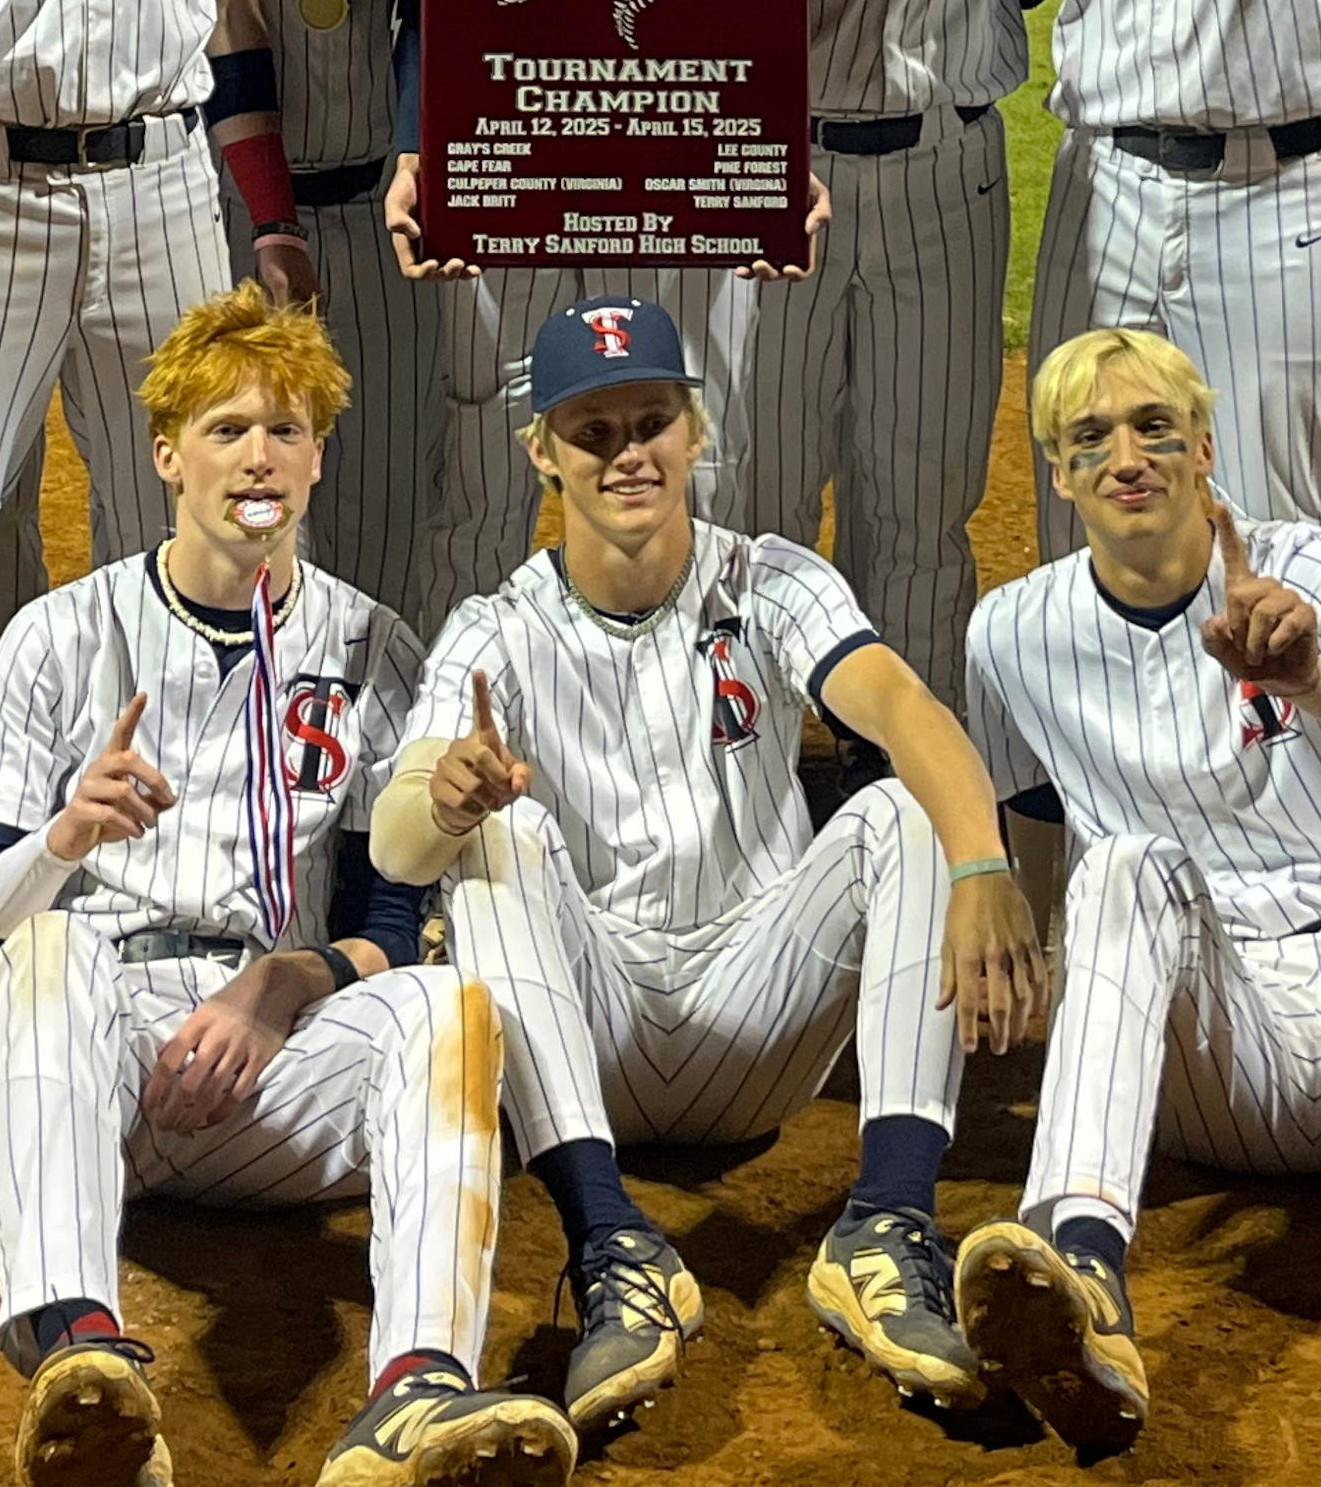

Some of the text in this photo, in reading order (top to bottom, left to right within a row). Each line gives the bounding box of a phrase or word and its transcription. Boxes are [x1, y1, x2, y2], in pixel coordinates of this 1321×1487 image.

[531, 118, 557, 137] 12,
[561, 118, 611, 136] 2025
[682, 118, 709, 138] 15,
[712, 118, 762, 137] 2025
[447, 142, 532, 156] GRAY'S CREEK
[717, 143, 788, 157] LEE COUNTY
[447, 160, 512, 173] CAPE FEAR
[713, 161, 788, 174] PINE FOREST
[447, 177, 508, 190] CULPEPER
[510, 178, 557, 190] COUNTY
[644, 178, 686, 191] OSCAR
[688, 178, 726, 191] SMITH
[447, 194, 517, 207] JACK BRITT
[693, 196, 788, 208] TERRY SANFORD
